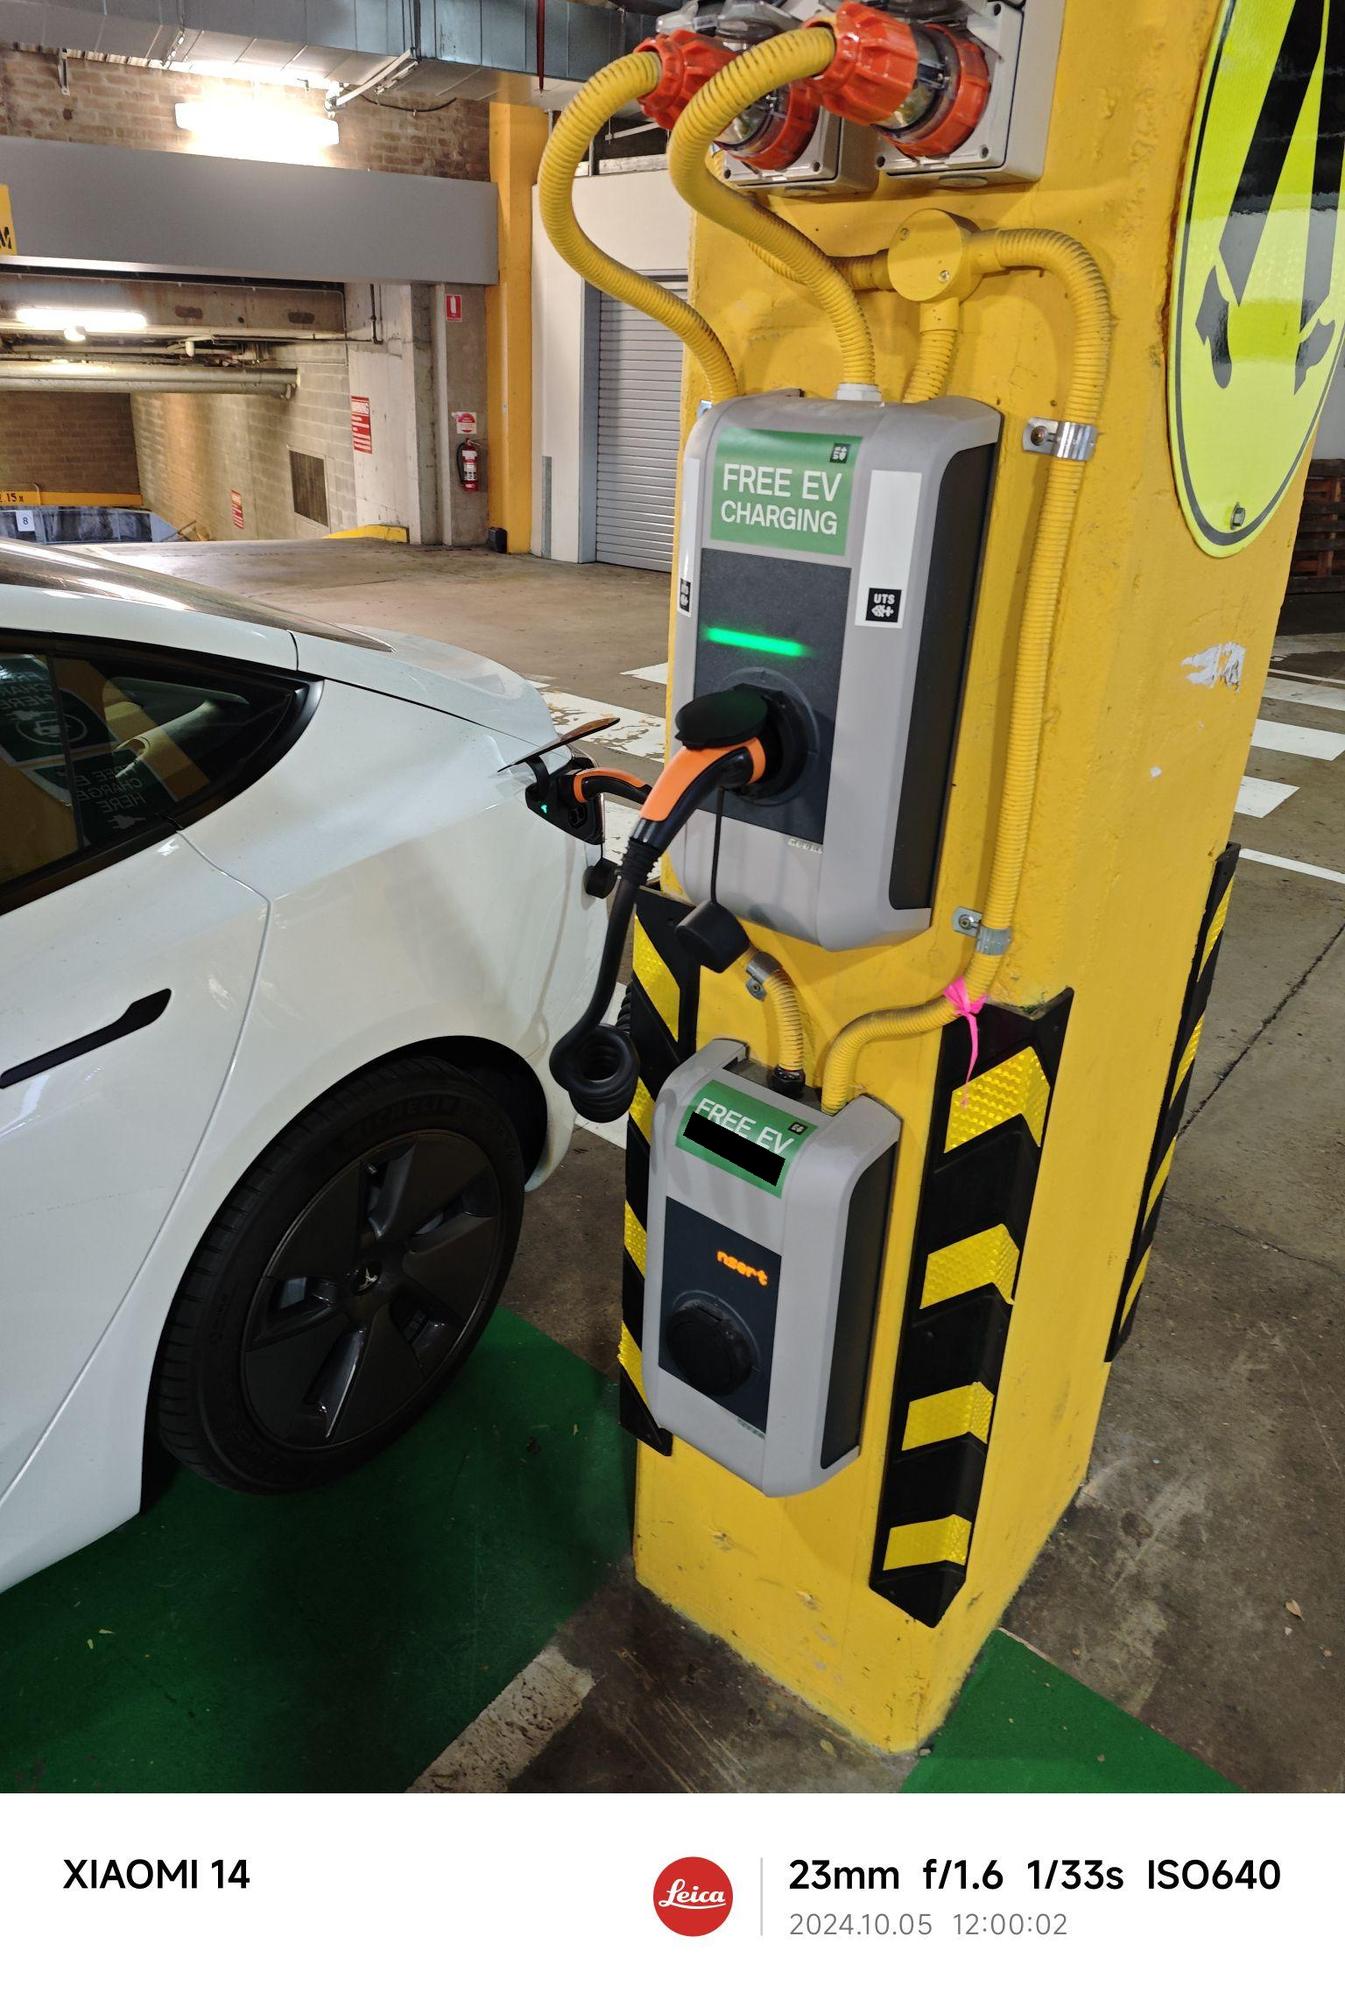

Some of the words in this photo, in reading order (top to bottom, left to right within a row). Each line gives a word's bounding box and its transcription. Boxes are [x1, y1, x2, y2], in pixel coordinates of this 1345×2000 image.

[723, 463, 793, 498] FREE
[802, 470, 843, 502] EV
[23, 516, 29, 526] 8
[720, 500, 838, 535] CHARGING
[874, 593, 895, 605] UTS
[695, 1098, 757, 1138] FREE
[756, 1126, 795, 1155] EV
